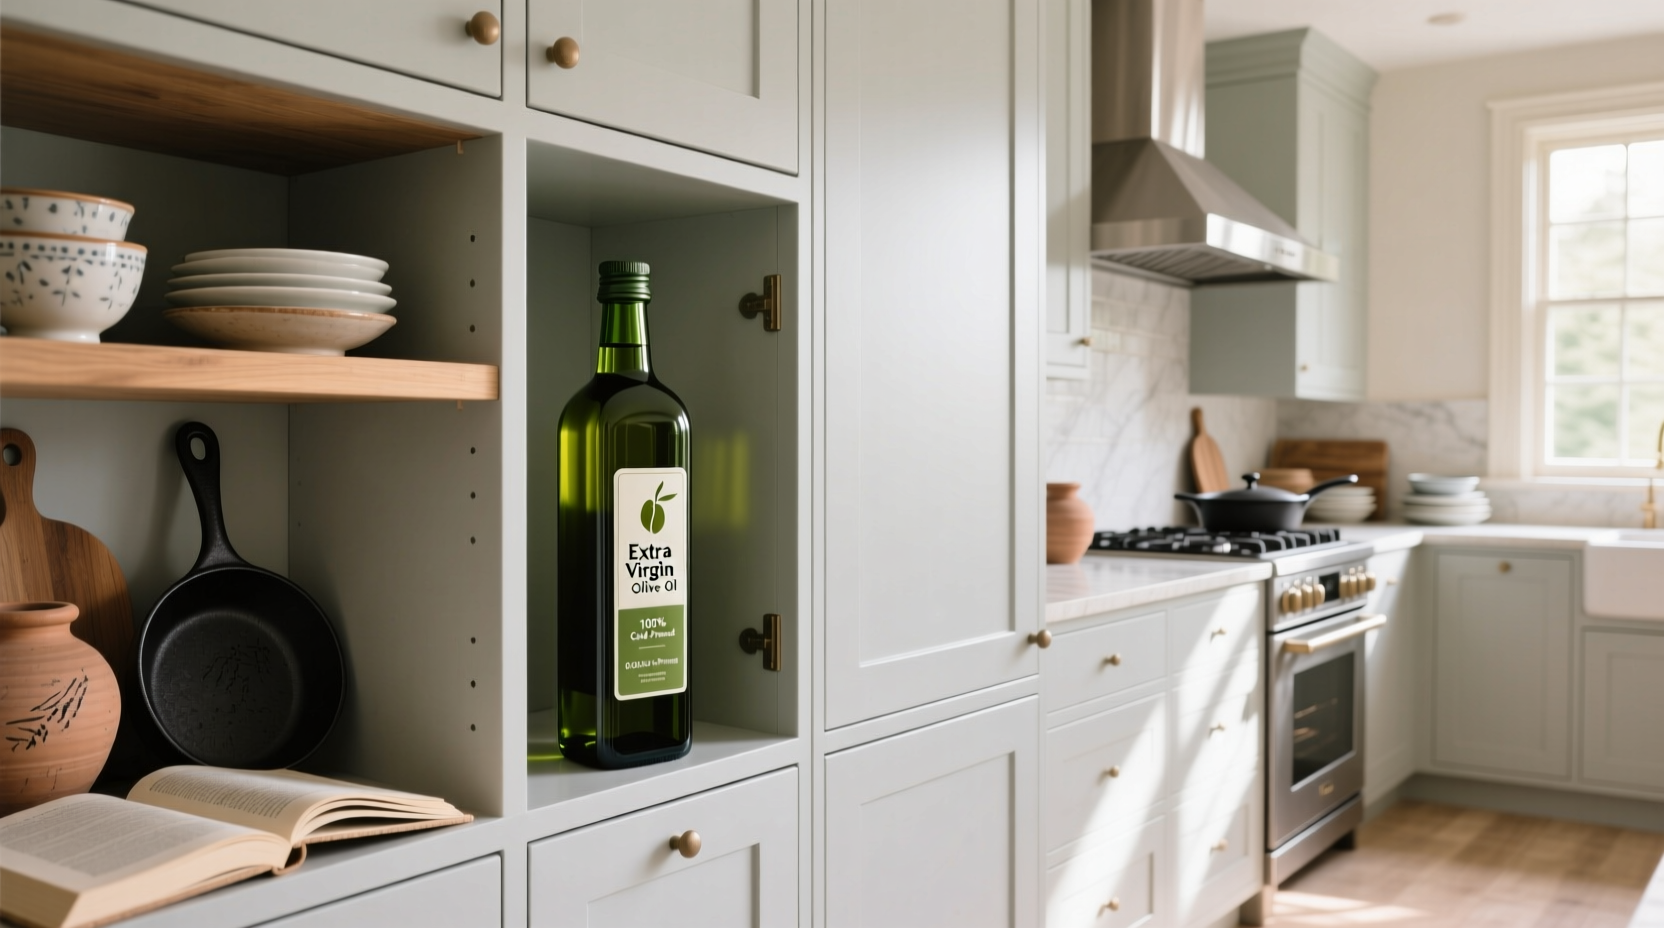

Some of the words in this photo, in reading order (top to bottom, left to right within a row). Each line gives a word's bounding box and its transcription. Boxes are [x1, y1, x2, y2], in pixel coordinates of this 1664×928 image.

[628, 543, 672, 560] Extra
[625, 561, 674, 581] Virgin
[631, 580, 661, 594] Olive
[639, 616, 667, 630] 100%
